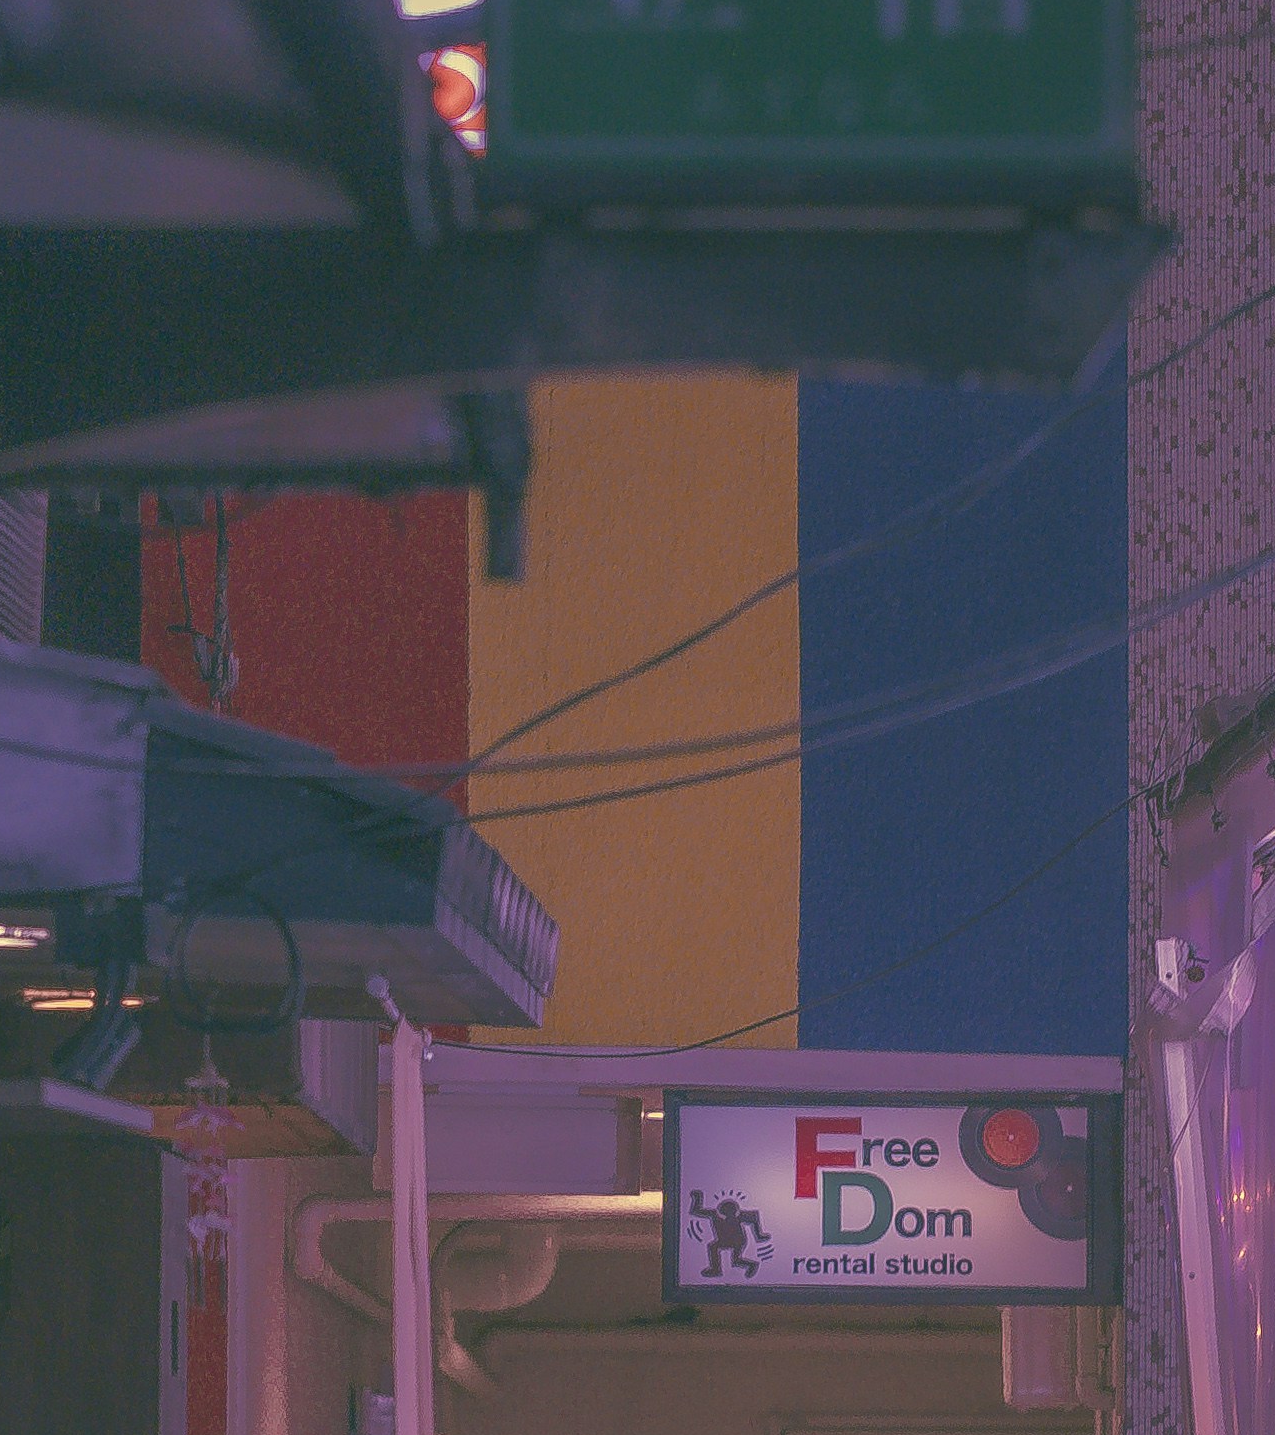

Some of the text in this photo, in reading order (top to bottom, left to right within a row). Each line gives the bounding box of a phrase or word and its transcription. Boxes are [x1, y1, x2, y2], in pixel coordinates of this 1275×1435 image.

[794, 1116, 940, 1200] Free
[822, 1171, 973, 1248] Dom
[792, 1253, 974, 1276] rental studio
